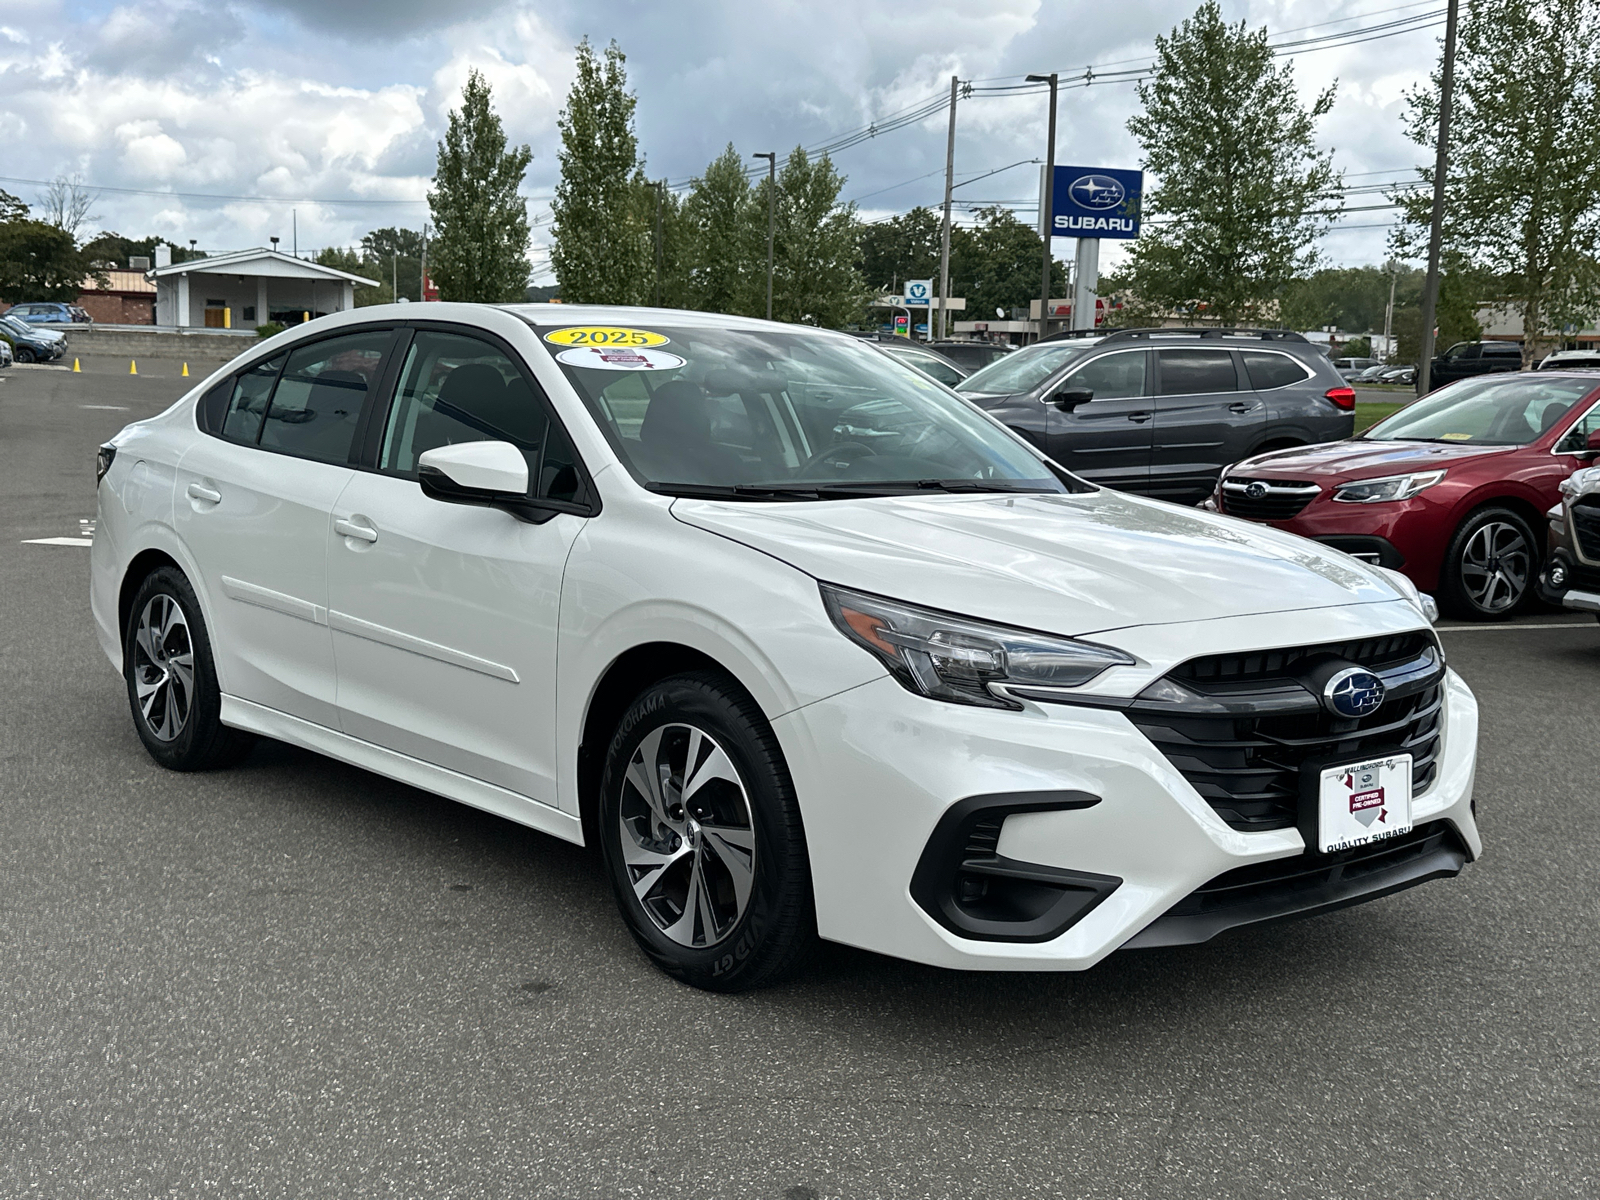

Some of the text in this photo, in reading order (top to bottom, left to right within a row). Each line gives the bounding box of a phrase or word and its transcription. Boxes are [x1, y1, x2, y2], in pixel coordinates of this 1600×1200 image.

[1054, 215, 1134, 231] SUBARU
[569, 331, 649, 345] 2025
[609, 693, 667, 758] YOKOHAMA
[1352, 798, 1382, 809] PRE-OWNED
[1354, 792, 1379, 802] CERTIFIED
[1327, 826, 1412, 853] QUALITY SUBARU
